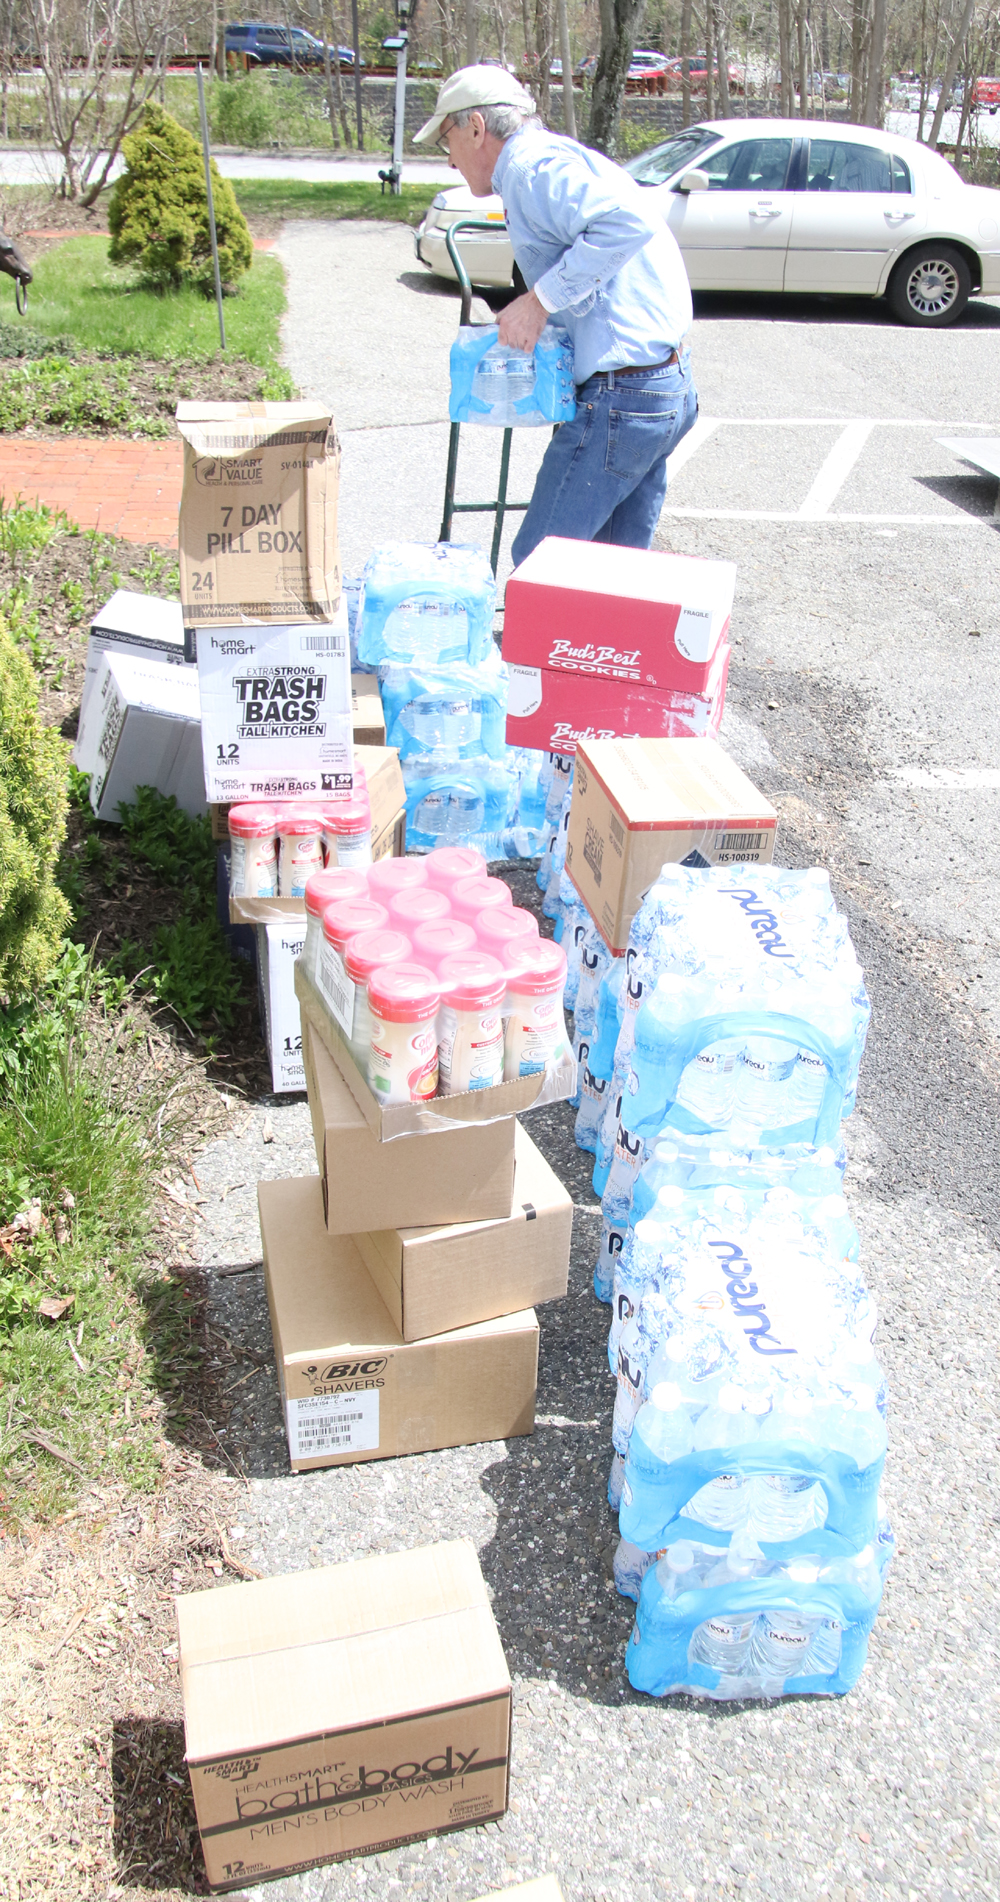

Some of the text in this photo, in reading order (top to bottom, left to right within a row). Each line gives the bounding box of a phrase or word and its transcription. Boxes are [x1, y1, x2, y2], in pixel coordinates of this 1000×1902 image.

[227, 458, 263, 468] SMART
[226, 468, 263, 480] VALUE
[220, 504, 282, 527] 7 DAY
[207, 531, 303, 554] PILL BOX
[191, 572, 214, 591] 24
[683, 609, 709, 619] FRAGILE
[211, 637, 245, 648] home
[221, 644, 256, 655] smart
[549, 639, 642, 666] Bud's Best
[247, 667, 315, 677] EXTRASTRONG
[513, 668, 538, 677] FRAGILE
[548, 660, 641, 680] COOKIES
[235, 677, 324, 701] TRASH
[245, 700, 317, 723] BAGS
[239, 725, 324, 737] TALL KITCHEN
[216, 743, 239, 759] 12
[216, 758, 240, 766] UNITS
[214, 777, 239, 785] home
[250, 781, 316, 792] TRASH BAGS
[324, 774, 351, 789] $1.99
[718, 853, 760, 862] HS-100319
[717, 889, 795, 958] pureau
[283, 1035, 302, 1051] 12
[707, 1241, 798, 1356] pureau
[313, 1378, 385, 1396] SHAVERS
[381, 1773, 433, 1793] BASICS
[250, 1777, 464, 1841] MEN'S BODY WASH
[222, 1860, 244, 1875] 12
